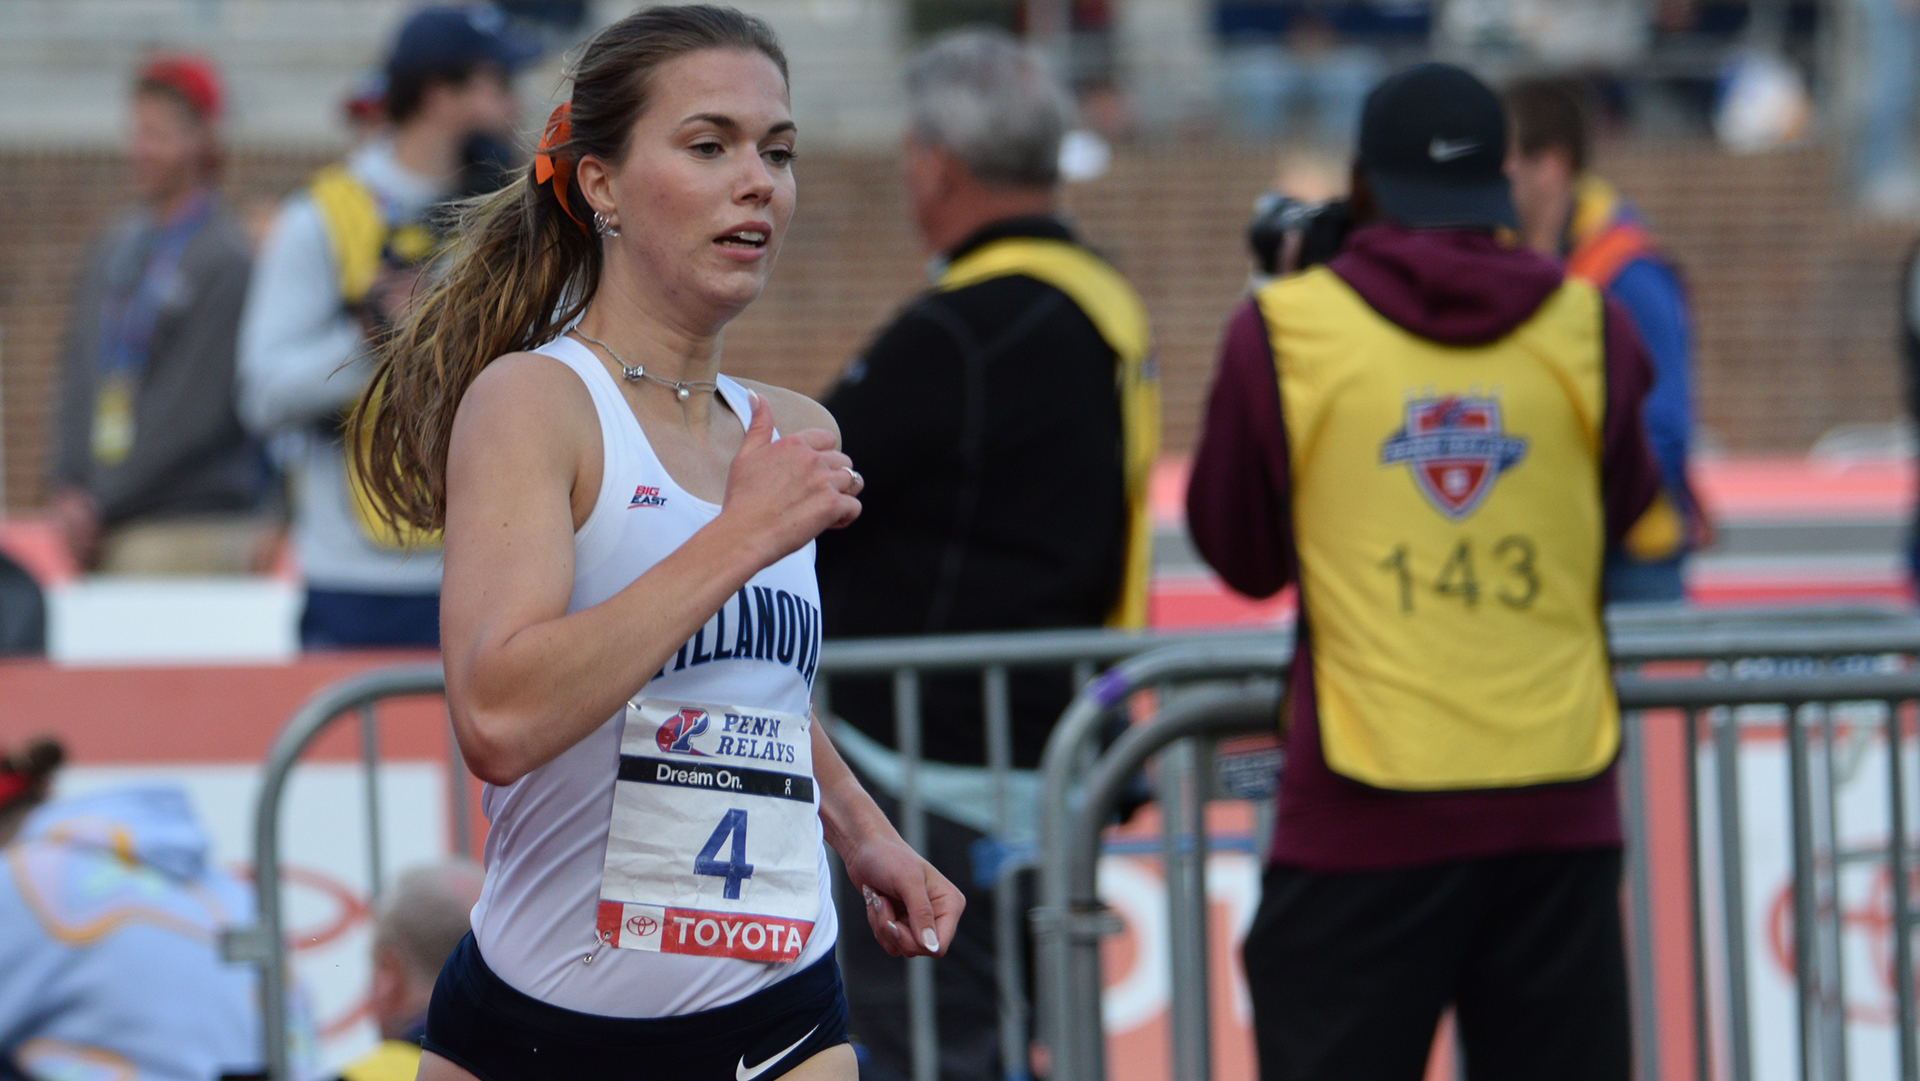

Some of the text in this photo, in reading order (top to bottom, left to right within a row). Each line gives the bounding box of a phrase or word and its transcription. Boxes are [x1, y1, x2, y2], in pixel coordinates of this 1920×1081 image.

[630, 495, 668, 506] EAST
[635, 485, 660, 496] BIG
[1377, 534, 1541, 615] 143
[651, 584, 819, 692] LLANOVA
[721, 713, 781, 738] PENN
[715, 735, 795, 764] RELAYS
[656, 763, 743, 790] Dream On.
[693, 808, 754, 900] 4
[673, 916, 802, 953] TOYOTA
